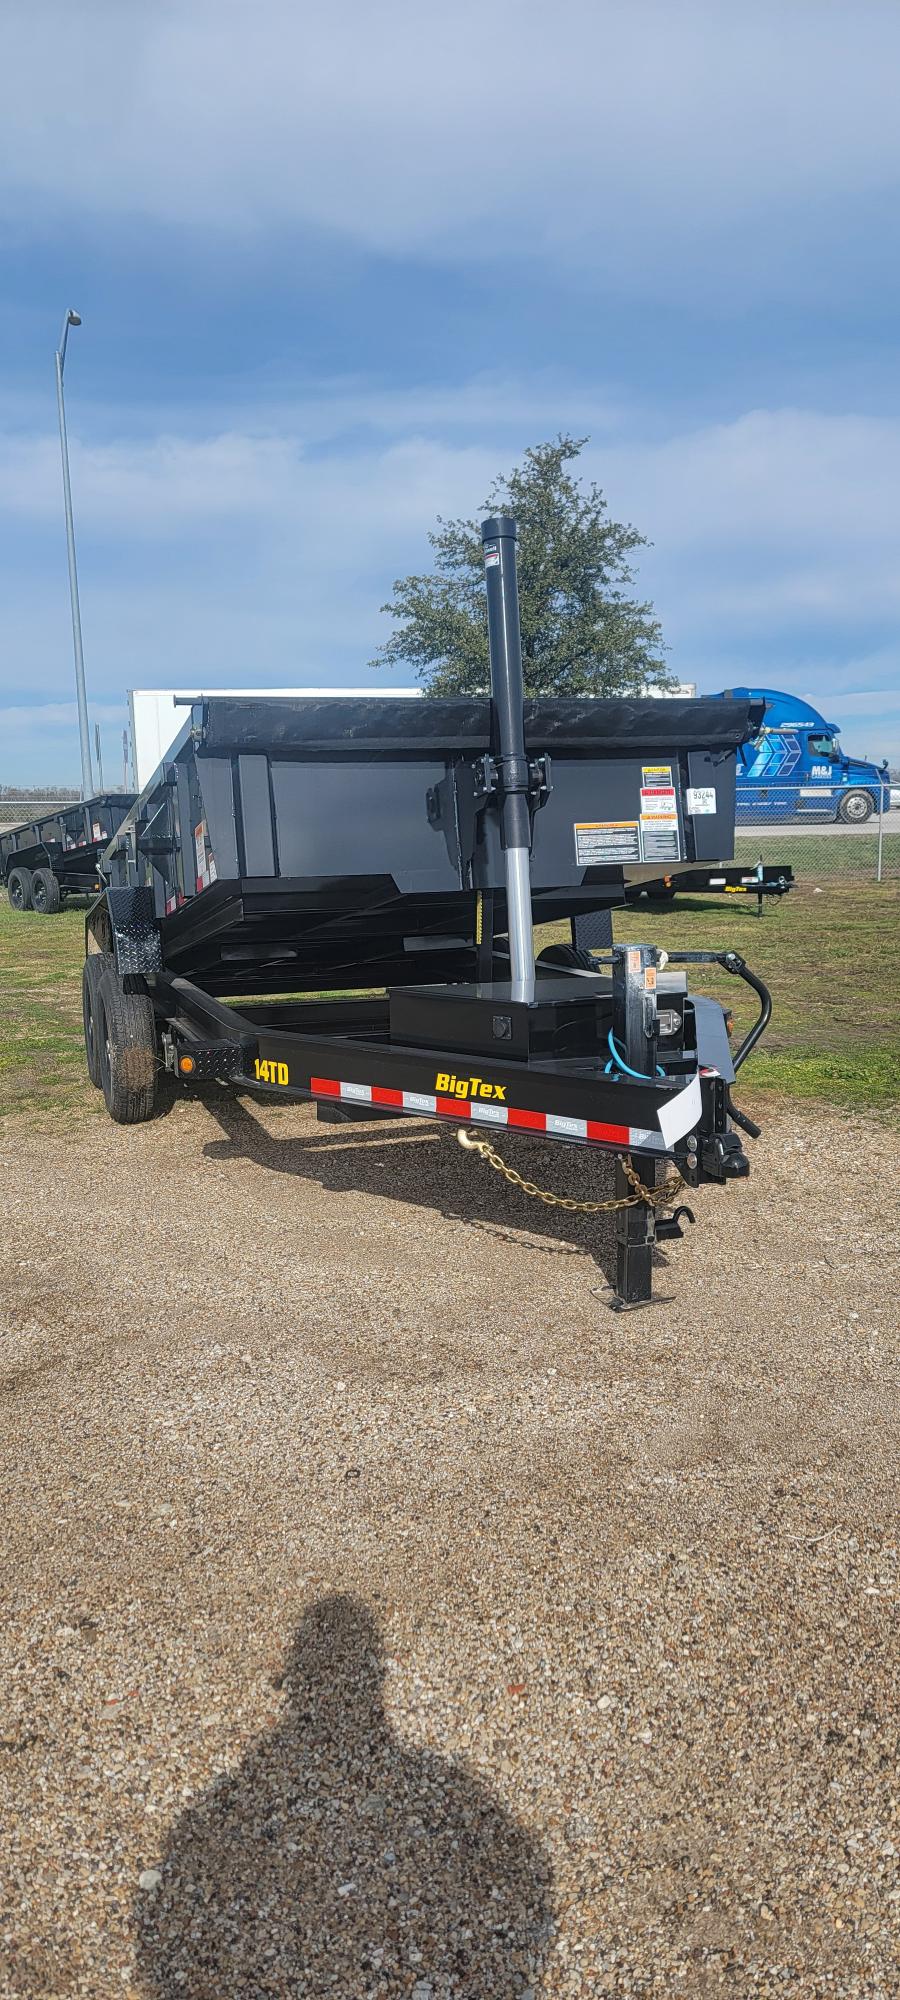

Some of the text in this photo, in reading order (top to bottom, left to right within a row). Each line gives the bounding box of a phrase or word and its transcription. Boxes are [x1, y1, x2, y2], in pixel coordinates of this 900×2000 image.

[811, 765, 832, 776] M&J
[254, 1058, 289, 1086] 14TD
[434, 1073, 508, 1100] BigTex
